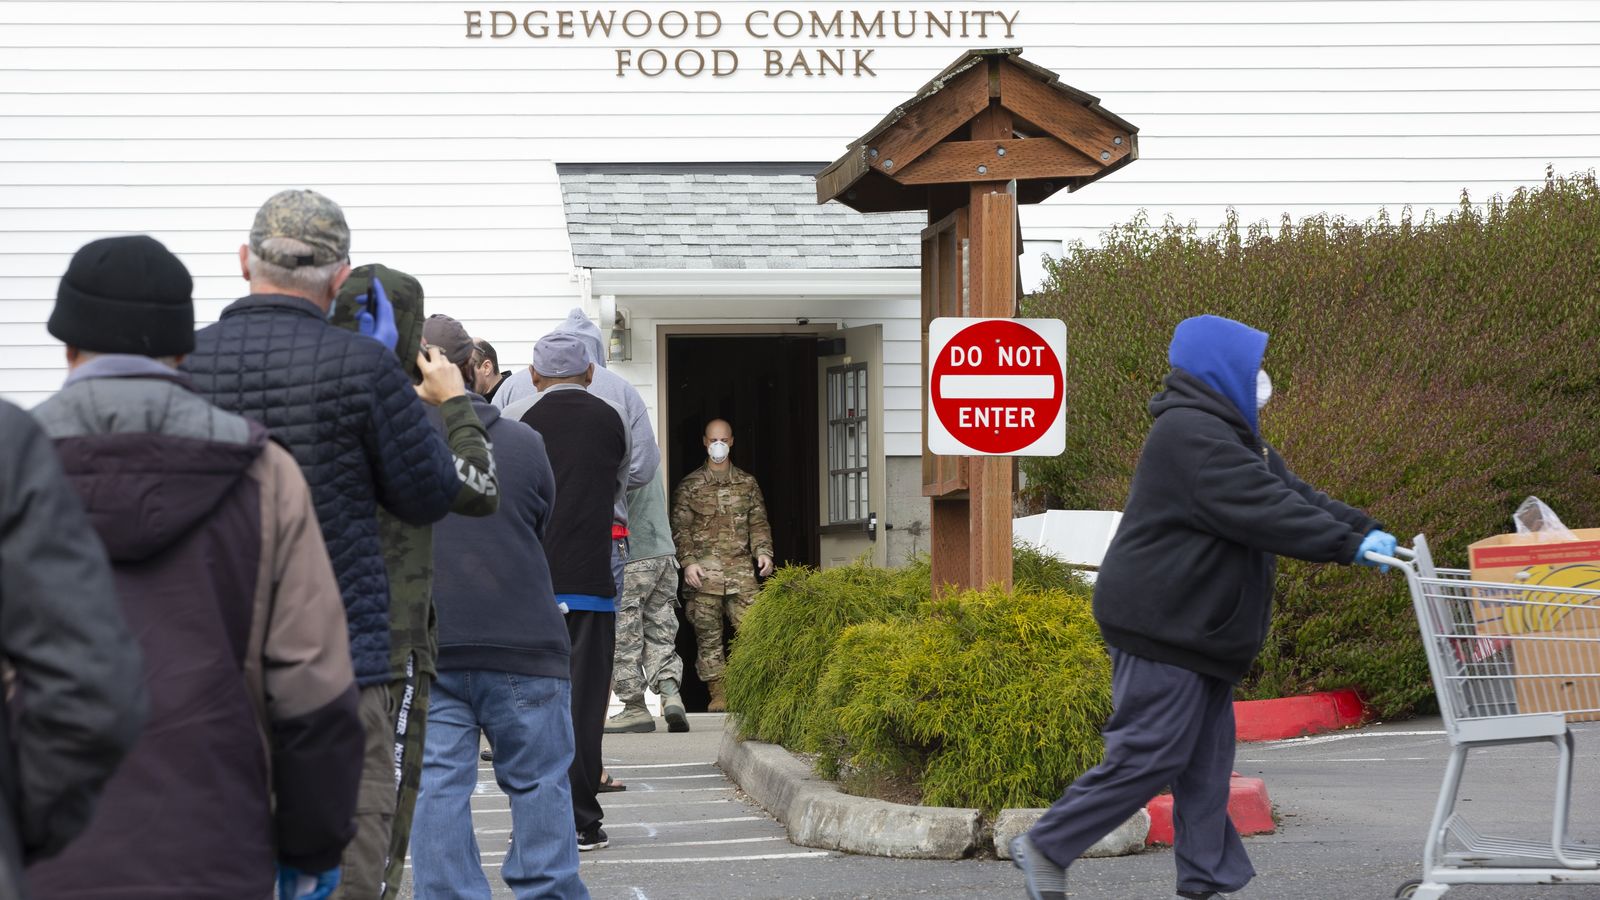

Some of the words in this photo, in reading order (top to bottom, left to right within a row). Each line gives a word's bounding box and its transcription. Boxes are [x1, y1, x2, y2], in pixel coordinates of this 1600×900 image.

[465, 10, 721, 39] EDGEWOOD
[746, 10, 1020, 39] COMMUNITY
[615, 48, 738, 78] FOOD
[765, 48, 877, 77] BANK
[950, 345, 983, 367] DO
[998, 345, 1045, 367] NOT
[959, 407, 1035, 428] ENTER
[396, 684, 414, 735] HOLLISTER
